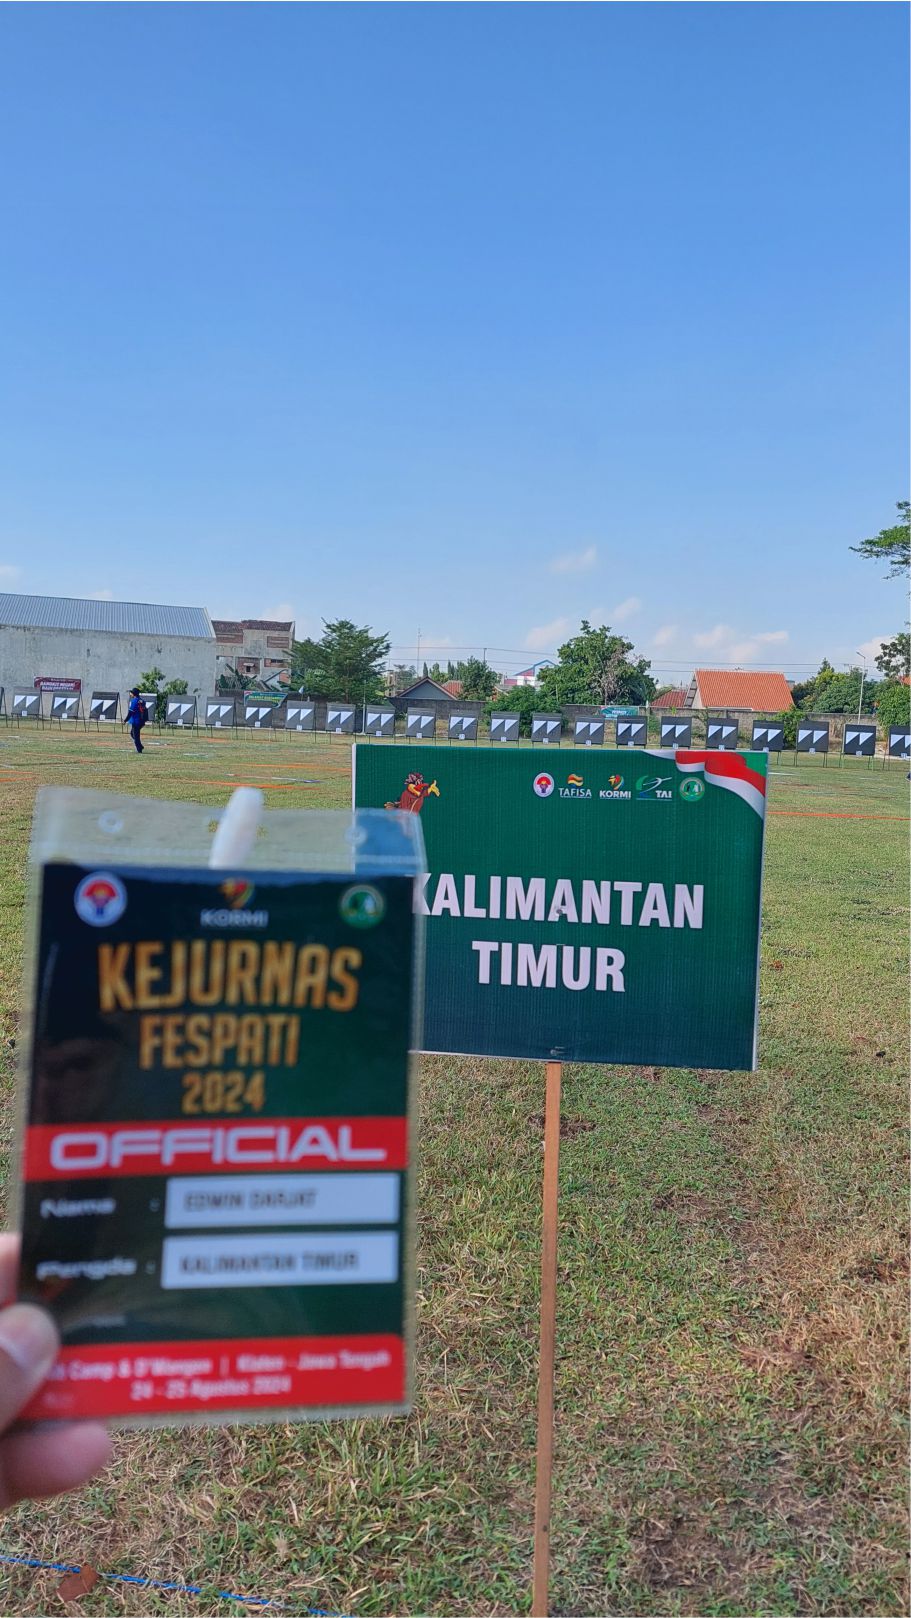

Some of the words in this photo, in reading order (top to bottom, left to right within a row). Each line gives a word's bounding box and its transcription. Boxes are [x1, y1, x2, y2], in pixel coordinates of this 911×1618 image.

[558, 787, 593, 798] TAFISA
[599, 790, 632, 799] KORMI
[655, 790, 673, 799] TAI
[200, 907, 269, 928] KORMI
[412, 872, 705, 929] KALIMANTAN
[98, 940, 362, 1012] KEJURNAS
[471, 940, 626, 993] TIMUR
[139, 1013, 300, 1068] FESPATI
[181, 1071, 266, 1114] 2024
[50, 1125, 387, 1171] OFFICIAL
